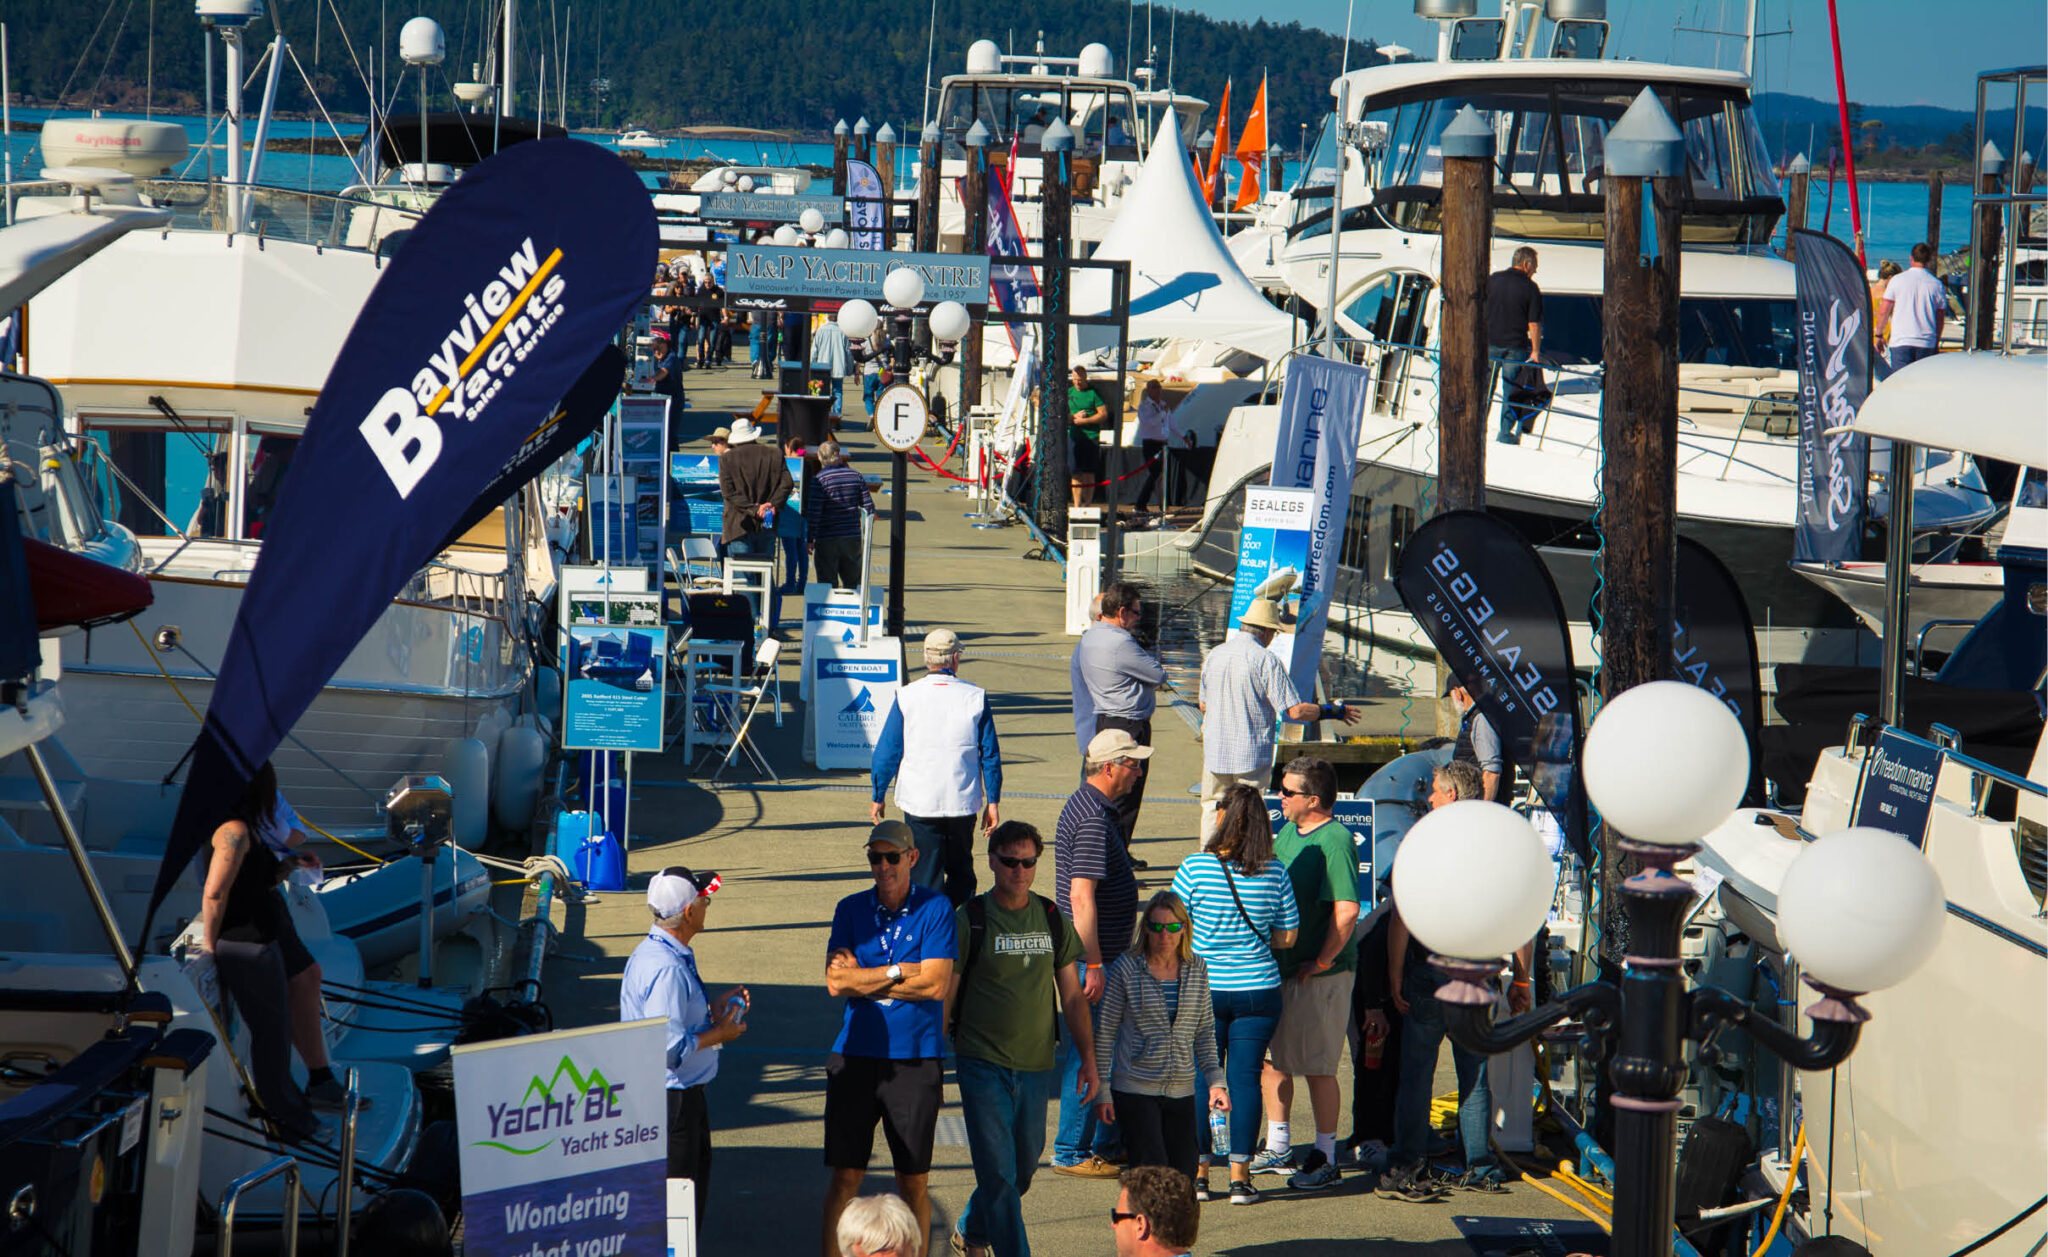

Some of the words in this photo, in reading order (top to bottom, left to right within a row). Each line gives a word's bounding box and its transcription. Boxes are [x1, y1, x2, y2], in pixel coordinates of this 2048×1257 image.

[75, 133, 142, 147] Raytheon
[742, 197, 782, 212] YACHT
[735, 252, 794, 280] M&P
[800, 255, 880, 284] YACHT
[885, 258, 982, 289] CNTRE
[748, 282, 799, 293] Vancouver's
[801, 284, 833, 293] Premier
[835, 286, 860, 295] Power
[943, 289, 967, 299] 1957
[438, 273, 566, 419] Yachts
[359, 236, 539, 500] Bayview
[465, 378, 503, 422] Sales
[502, 362, 516, 377] &
[514, 303, 565, 362] Service
[893, 402, 910, 431] F
[1250, 499, 1305, 513] SEALEGS
[837, 664, 859, 672] OPEN
[861, 664, 883, 672] BOAT
[487, 1093, 577, 1139] Yacht
[584, 1083, 626, 1123] BC
[561, 1131, 609, 1156] Yacht
[613, 1124, 660, 1148] Sales
[504, 1186, 630, 1234] Wondering
